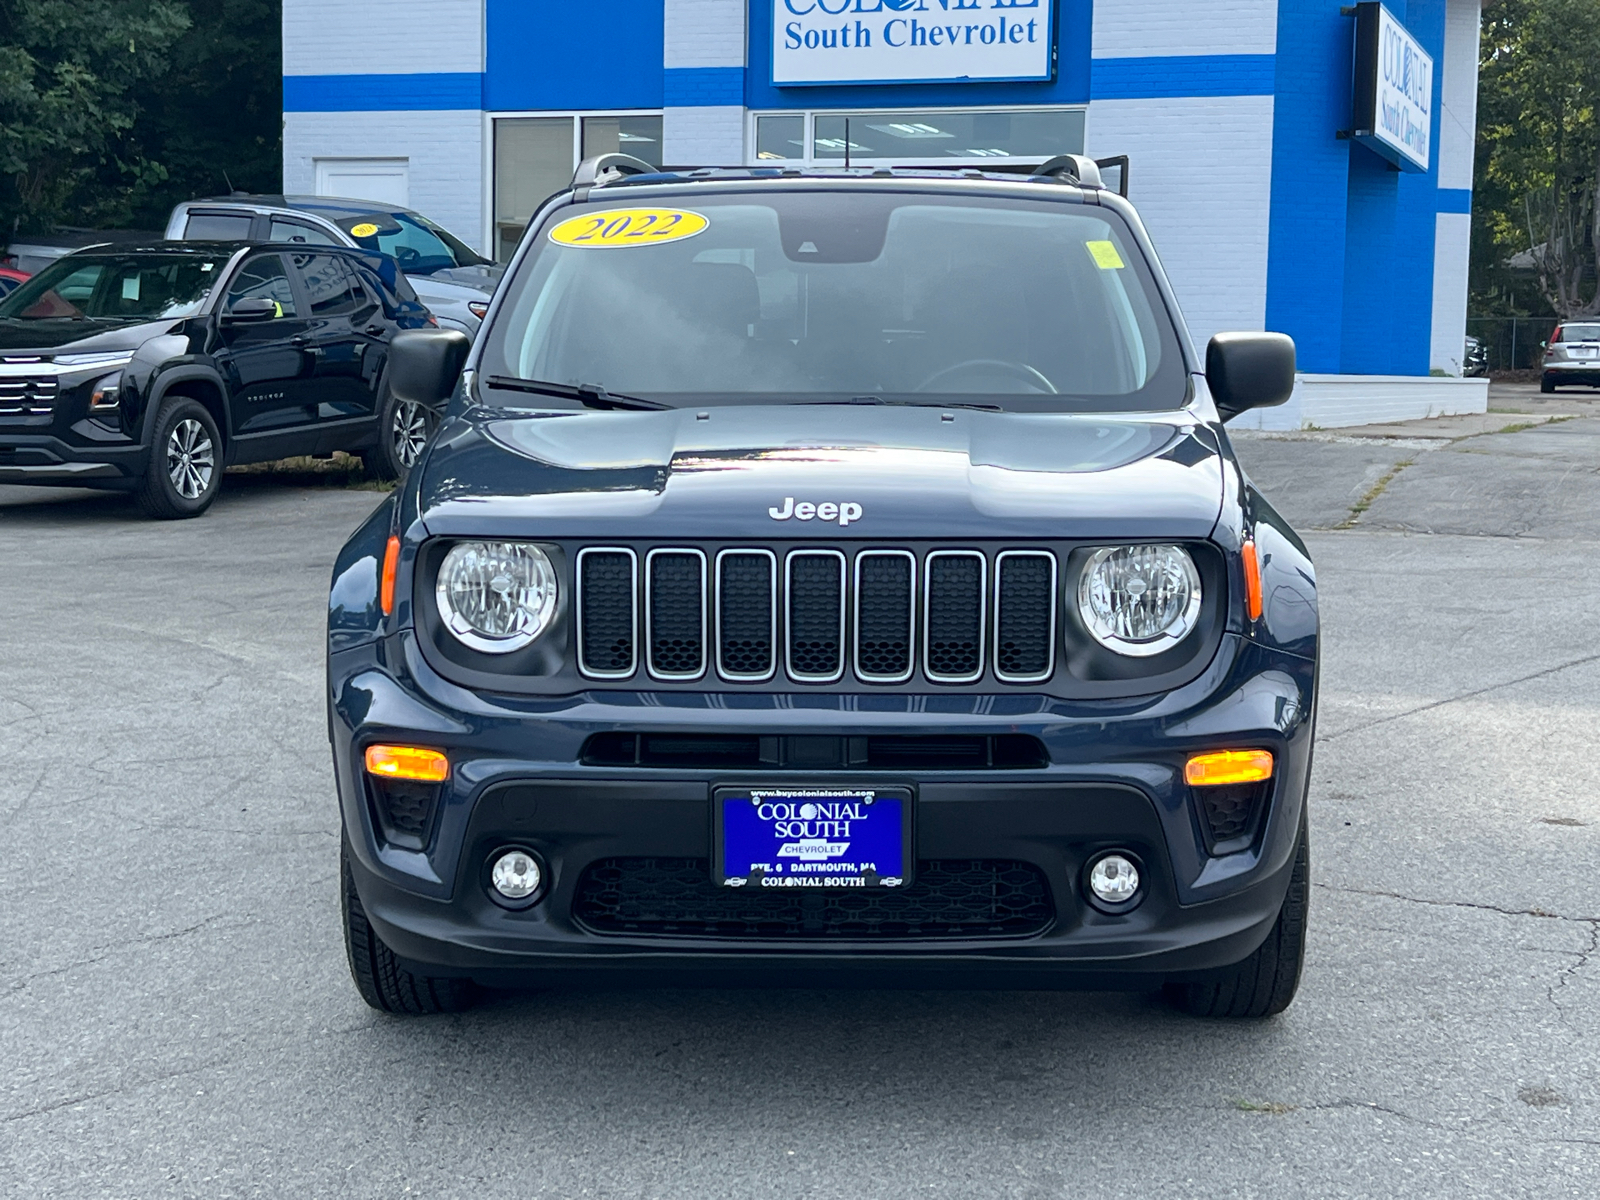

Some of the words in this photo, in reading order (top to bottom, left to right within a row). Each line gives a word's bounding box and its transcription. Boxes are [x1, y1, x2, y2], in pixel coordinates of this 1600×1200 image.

[785, 21, 872, 50] South
[883, 16, 1038, 47] Chevrolet
[572, 214, 683, 241] 2022
[768, 497, 863, 526] Jeep
[757, 803, 868, 820] COLONIAL
[775, 821, 851, 838] SOUTH
[785, 845, 842, 853] CHEVROLET
[775, 863, 783, 872] 6
[791, 863, 858, 873] DARTMOUTH,
[761, 877, 823, 887] COLONIAL
[824, 877, 866, 887] SOUTH
